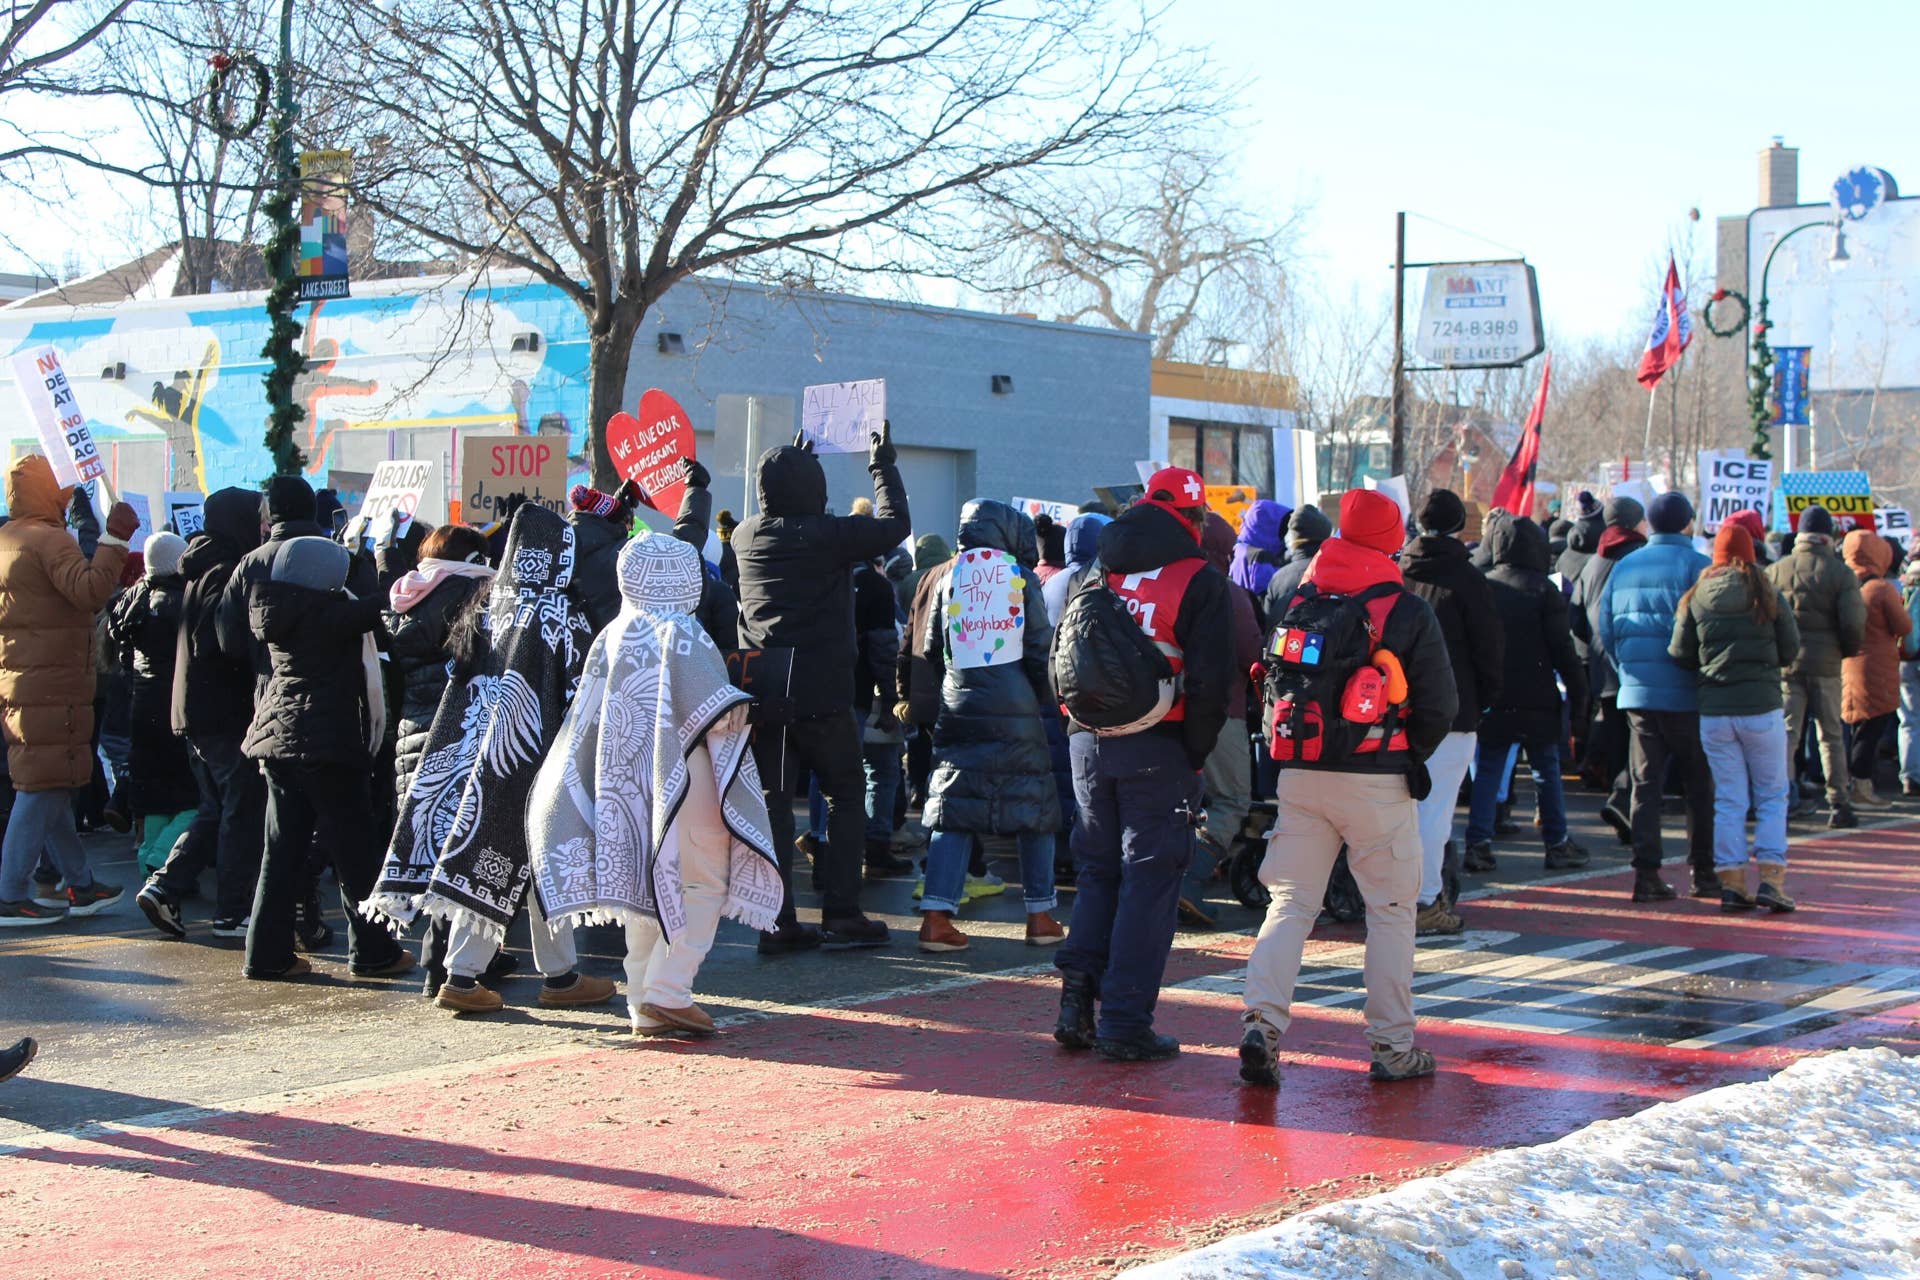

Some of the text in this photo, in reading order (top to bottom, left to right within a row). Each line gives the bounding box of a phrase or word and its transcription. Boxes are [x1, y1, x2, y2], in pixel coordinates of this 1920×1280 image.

[301, 279, 346, 298] LAKE STREET
[809, 382, 882, 409] ALL ARE
[61, 414, 82, 430] NO
[614, 415, 680, 460] WE LOVE OUR
[491, 444, 551, 477] STOP
[627, 439, 677, 480] IMMIGRANT
[1714, 460, 1768, 480] ICE
[371, 465, 432, 489] ABOLISH
[1711, 484, 1767, 495] OUT OF
[1825, 496, 1870, 512] OUT
[960, 565, 1009, 588] LOVE
[963, 586, 992, 611] Thy
